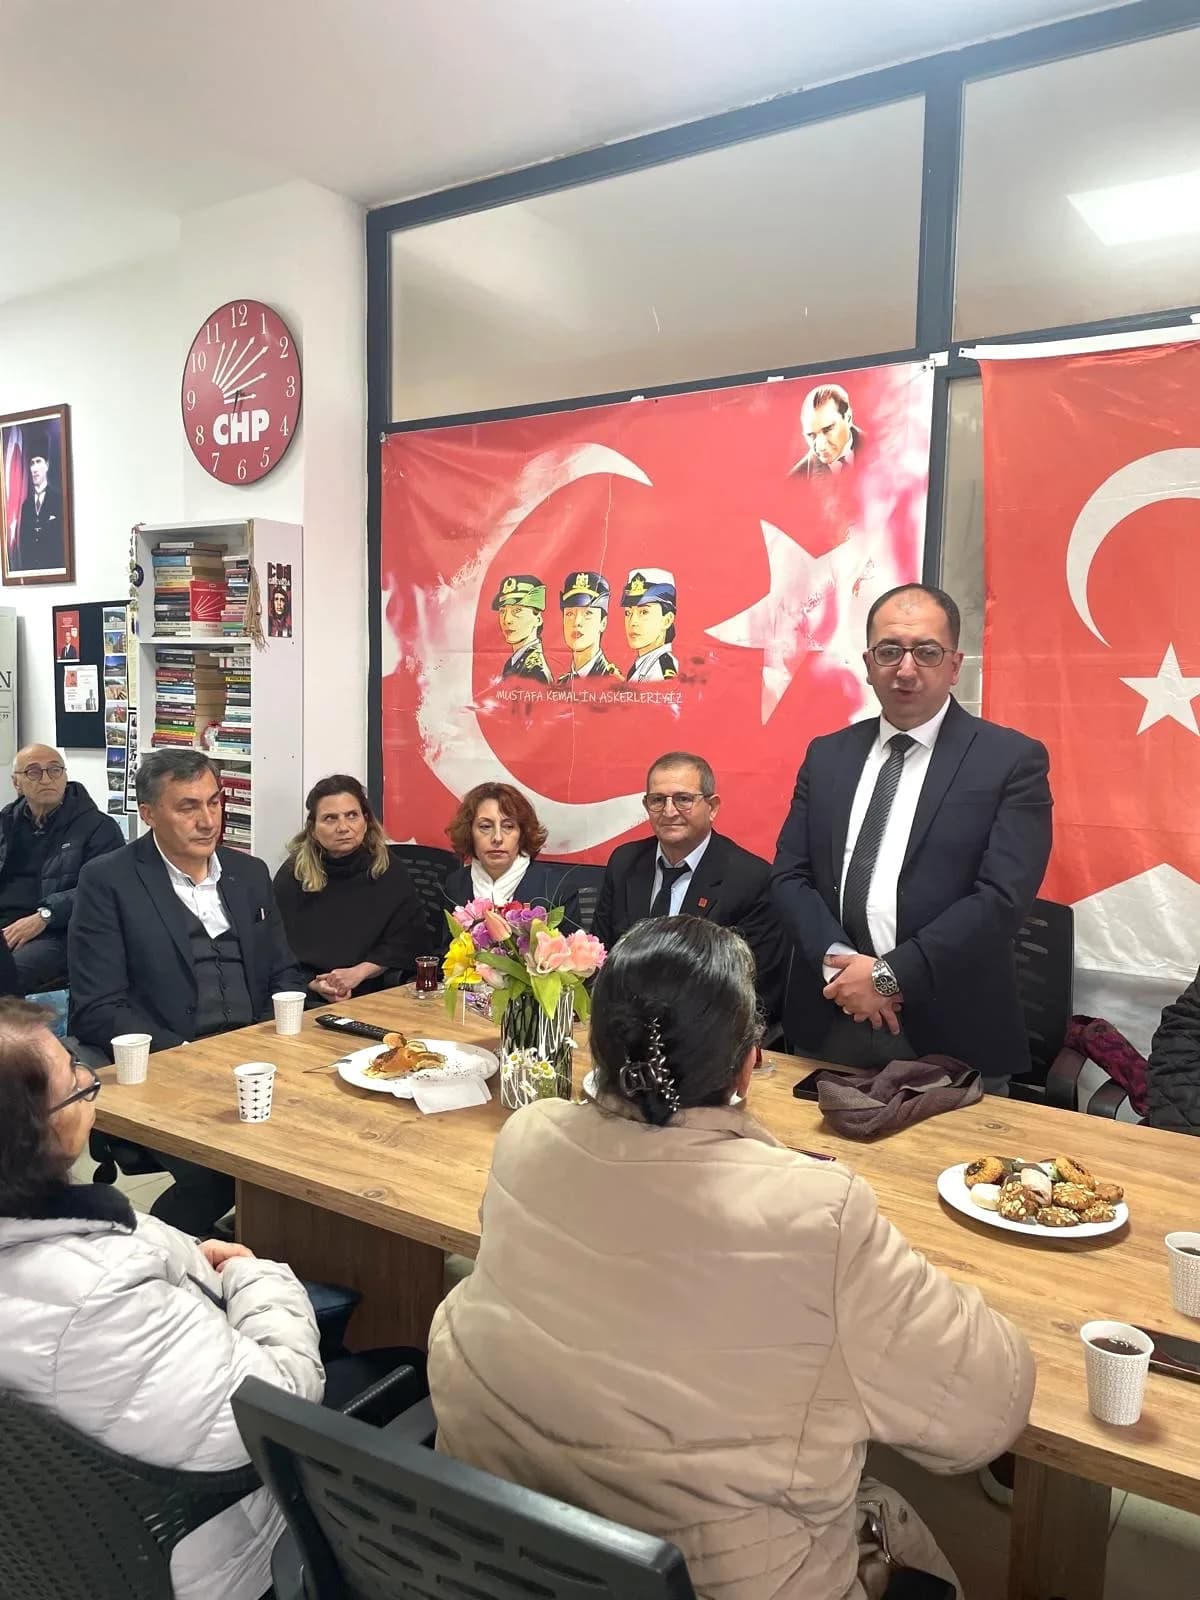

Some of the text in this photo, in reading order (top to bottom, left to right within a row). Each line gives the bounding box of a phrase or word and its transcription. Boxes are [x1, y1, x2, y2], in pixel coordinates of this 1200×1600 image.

[231, 304, 248, 329] 12
[260, 313, 268, 335] 1
[206, 322, 221, 345] 11
[279, 336, 289, 359] 2
[191, 352, 207, 374] 10
[286, 375, 296, 398] 3
[186, 390, 196, 412] 9
[195, 425, 205, 446] 8
[213, 409, 270, 446] CHP
[279, 415, 289, 437] 4
[211, 452, 220, 473] 7
[260, 446, 270, 468] 5
[237, 459, 247, 480] 6
[496, 689, 543, 702] MUSTAFA
